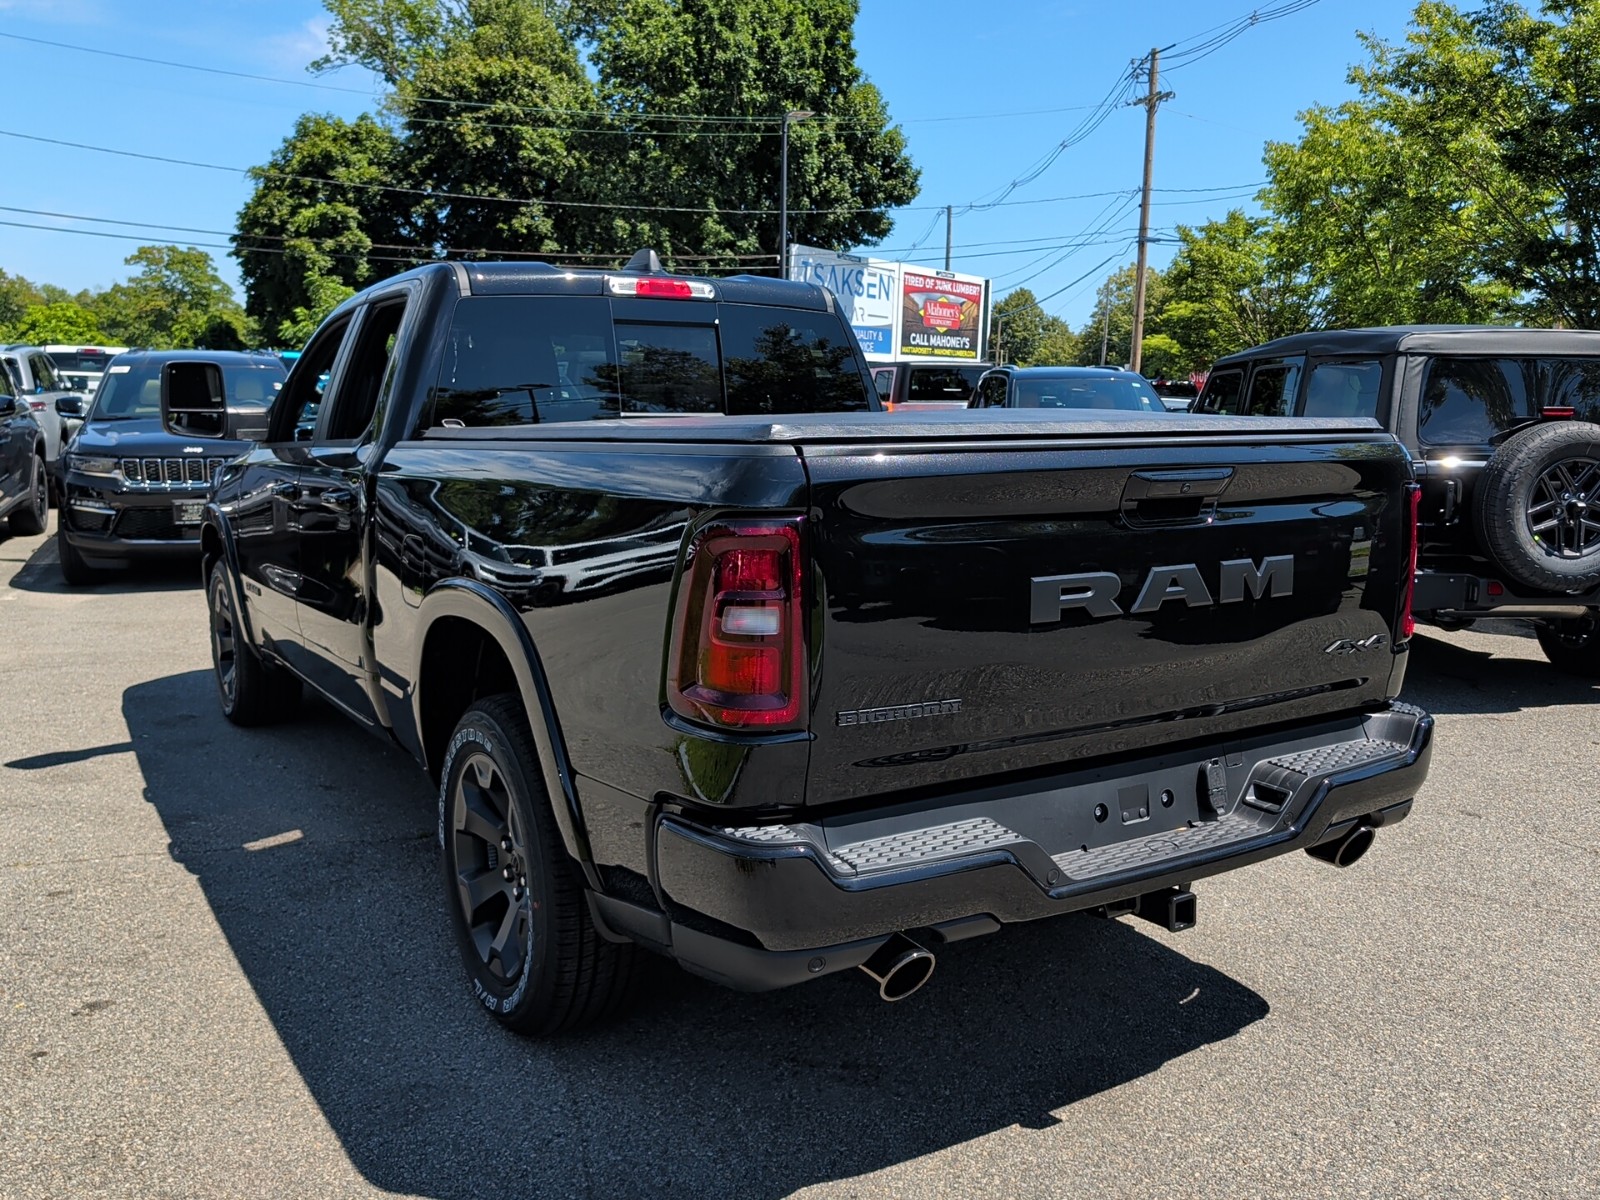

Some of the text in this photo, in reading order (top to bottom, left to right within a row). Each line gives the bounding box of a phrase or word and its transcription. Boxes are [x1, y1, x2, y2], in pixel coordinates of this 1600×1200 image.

[904, 274, 924, 288] TIRED
[925, 278, 935, 289] OF
[935, 279, 953, 292] JUNK
[952, 282, 980, 296] LUMBER?
[910, 333, 970, 349] CALL MAHONEY'S
[1030, 554, 1294, 624] RAM
